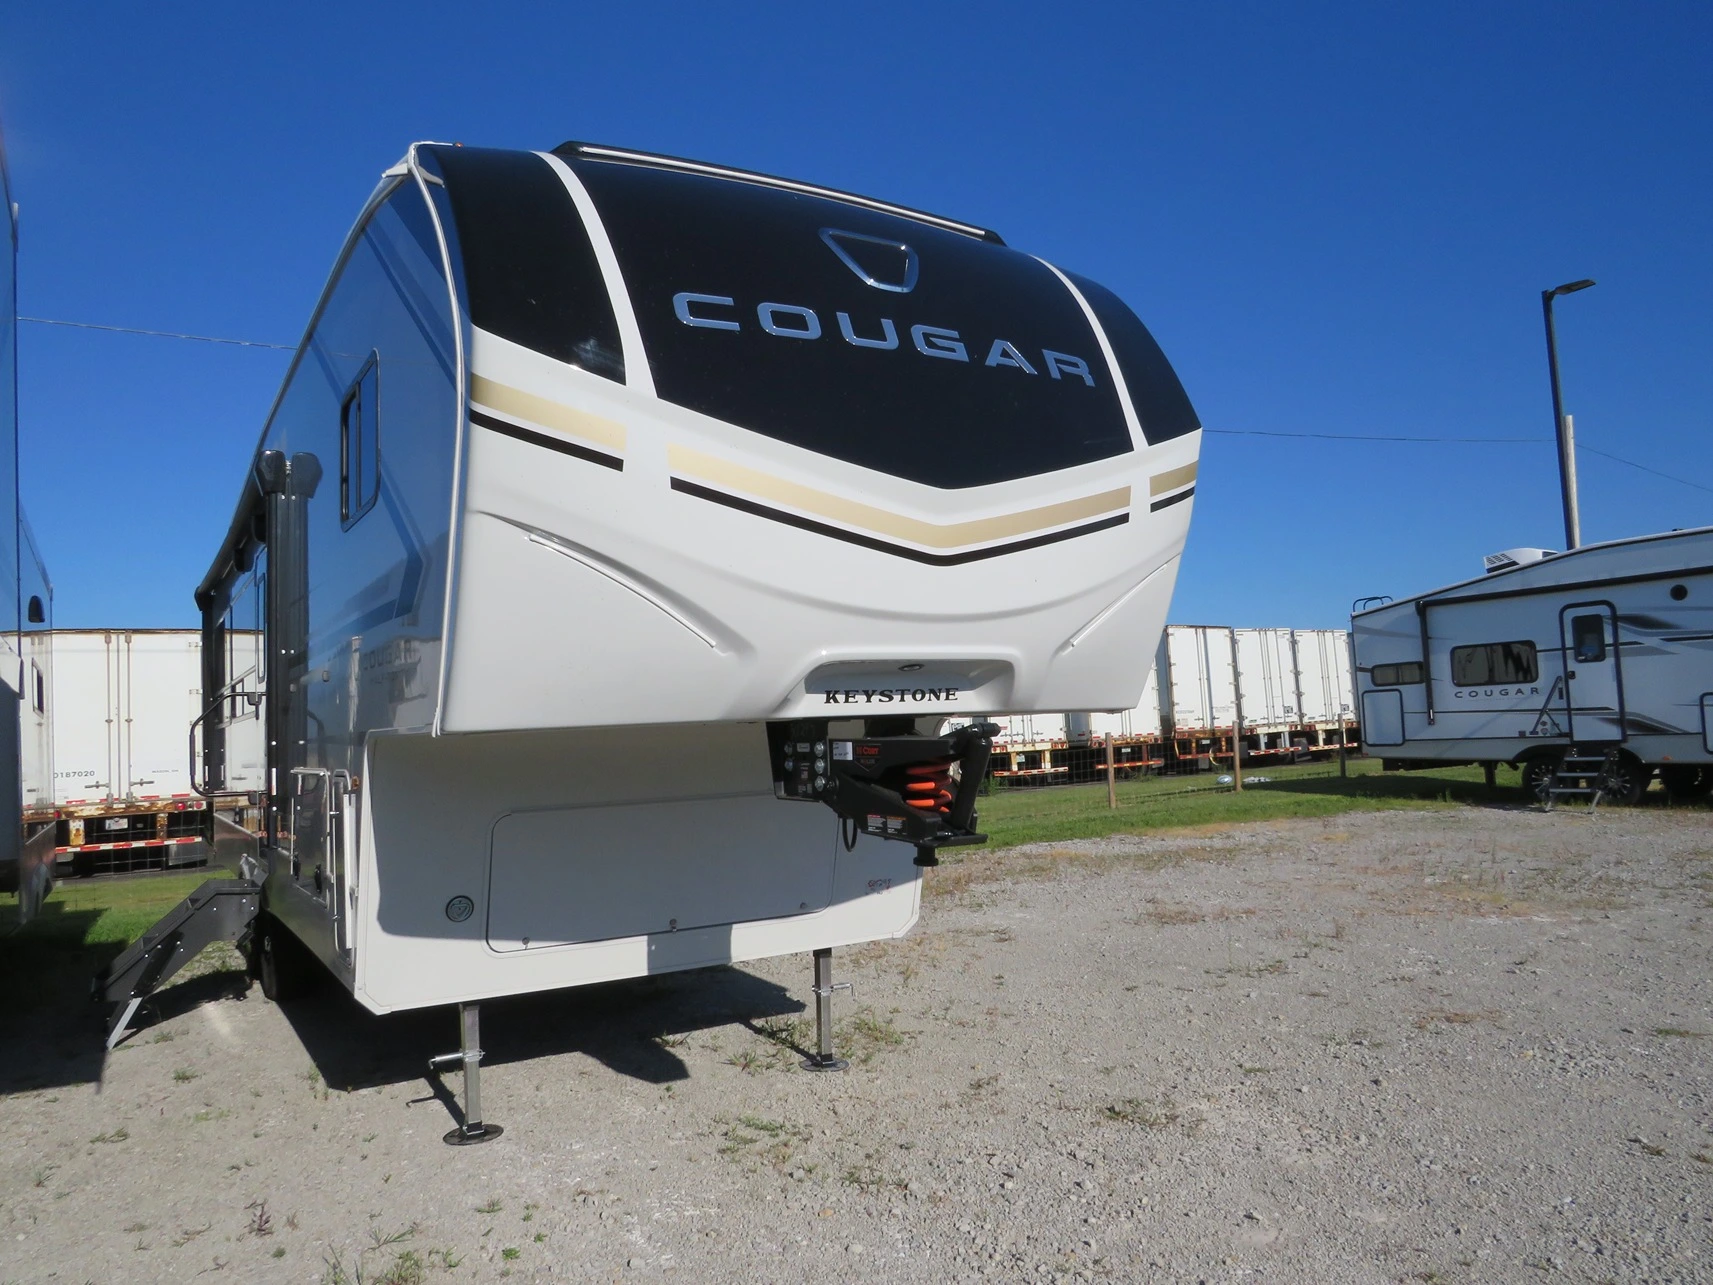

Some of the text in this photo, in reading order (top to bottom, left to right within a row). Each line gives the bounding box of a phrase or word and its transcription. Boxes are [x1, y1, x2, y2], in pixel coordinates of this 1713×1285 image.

[672, 292, 1096, 387] COUGAR
[824, 687, 959, 704] KEYSTONE
[1454, 687, 1539, 698] COUGAR
